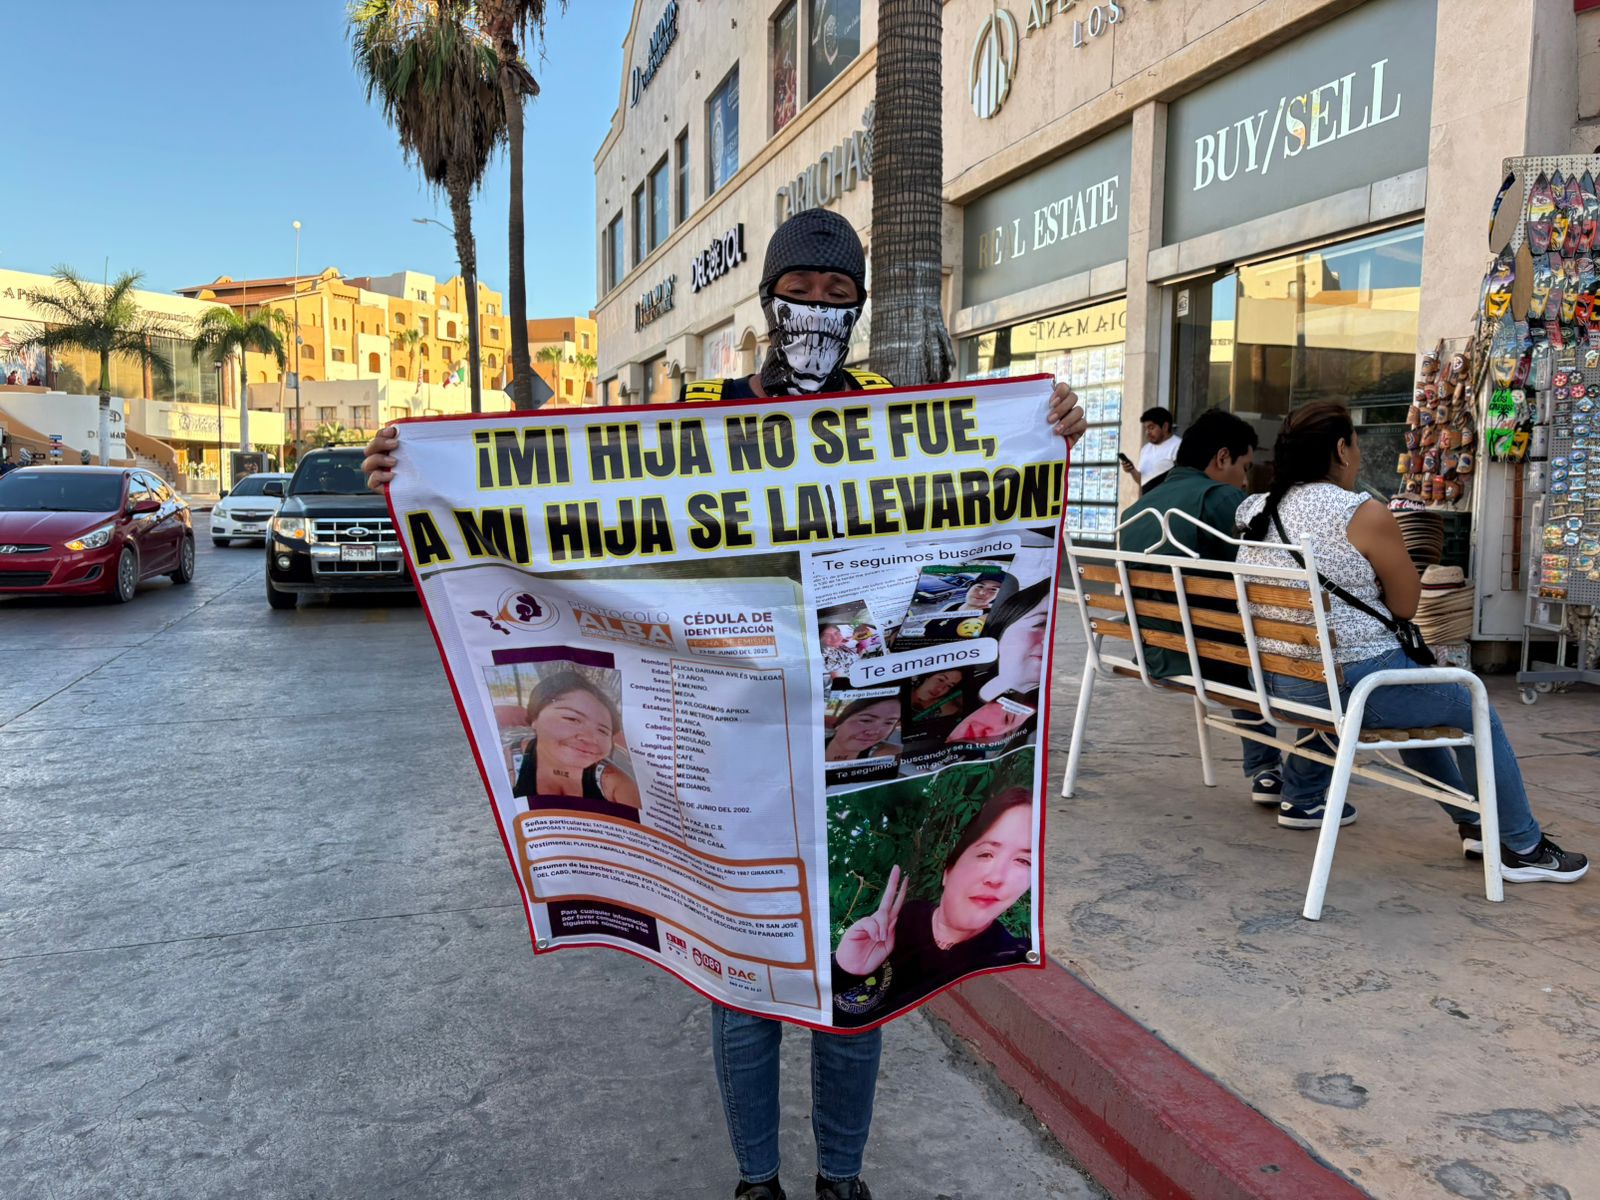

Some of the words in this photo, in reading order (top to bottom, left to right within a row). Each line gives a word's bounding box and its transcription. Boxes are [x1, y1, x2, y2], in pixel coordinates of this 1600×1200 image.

[1073, 0, 1120, 48] LOS
[1193, 58, 1402, 191] BUY/SELL
[1032, 175, 1119, 250] ESTATE
[474, 426, 571, 489] ¡MI
[586, 419, 713, 482] HIJA
[724, 413, 797, 474] NO
[810, 407, 876, 464] SE
[887, 397, 998, 459] FUE,
[407, 511, 453, 567] A
[453, 505, 532, 566] MI
[544, 496, 676, 562] HIJA
[687, 488, 754, 550] SE
[766, 483, 830, 543] LA
[823, 560, 844, 571] Te
[849, 552, 934, 569] seguimos
[939, 540, 1013, 560] buscando
[683, 612, 750, 626] CÉDULA
[752, 611, 773, 623] DE
[577, 611, 674, 644] ALBA
[684, 624, 774, 637] IDENTIFICACIÓN
[640, 658, 670, 666] Nombre:
[673, 664, 694, 672] ALICIA
[726, 671, 748, 680] AVILÉS
[861, 665, 886, 680] Te
[892, 647, 981, 673] amamos
[684, 700, 725, 713] KILOGRAMOS
[690, 710, 714, 721] METROS
[645, 723, 672, 731] Cabello:
[676, 726, 707, 738] CASTAÑO.
[640, 742, 674, 750] Longitud:
[656, 734, 673, 742] Tipo:
[676, 734, 712, 747] ONDULADO.
[656, 753, 674, 761] ojos:
[835, 770, 848, 780] Te
[850, 761, 900, 777] seguimos
[900, 749, 947, 764] buscando
[676, 763, 712, 774] MEDIANOS.
[676, 782, 712, 793] MEDIANOS.
[696, 803, 717, 812] JUNIO
[524, 820, 548, 828] Señas
[532, 862, 568, 872] Resumen
[703, 954, 722, 974] 089
[728, 966, 757, 982] DAC
